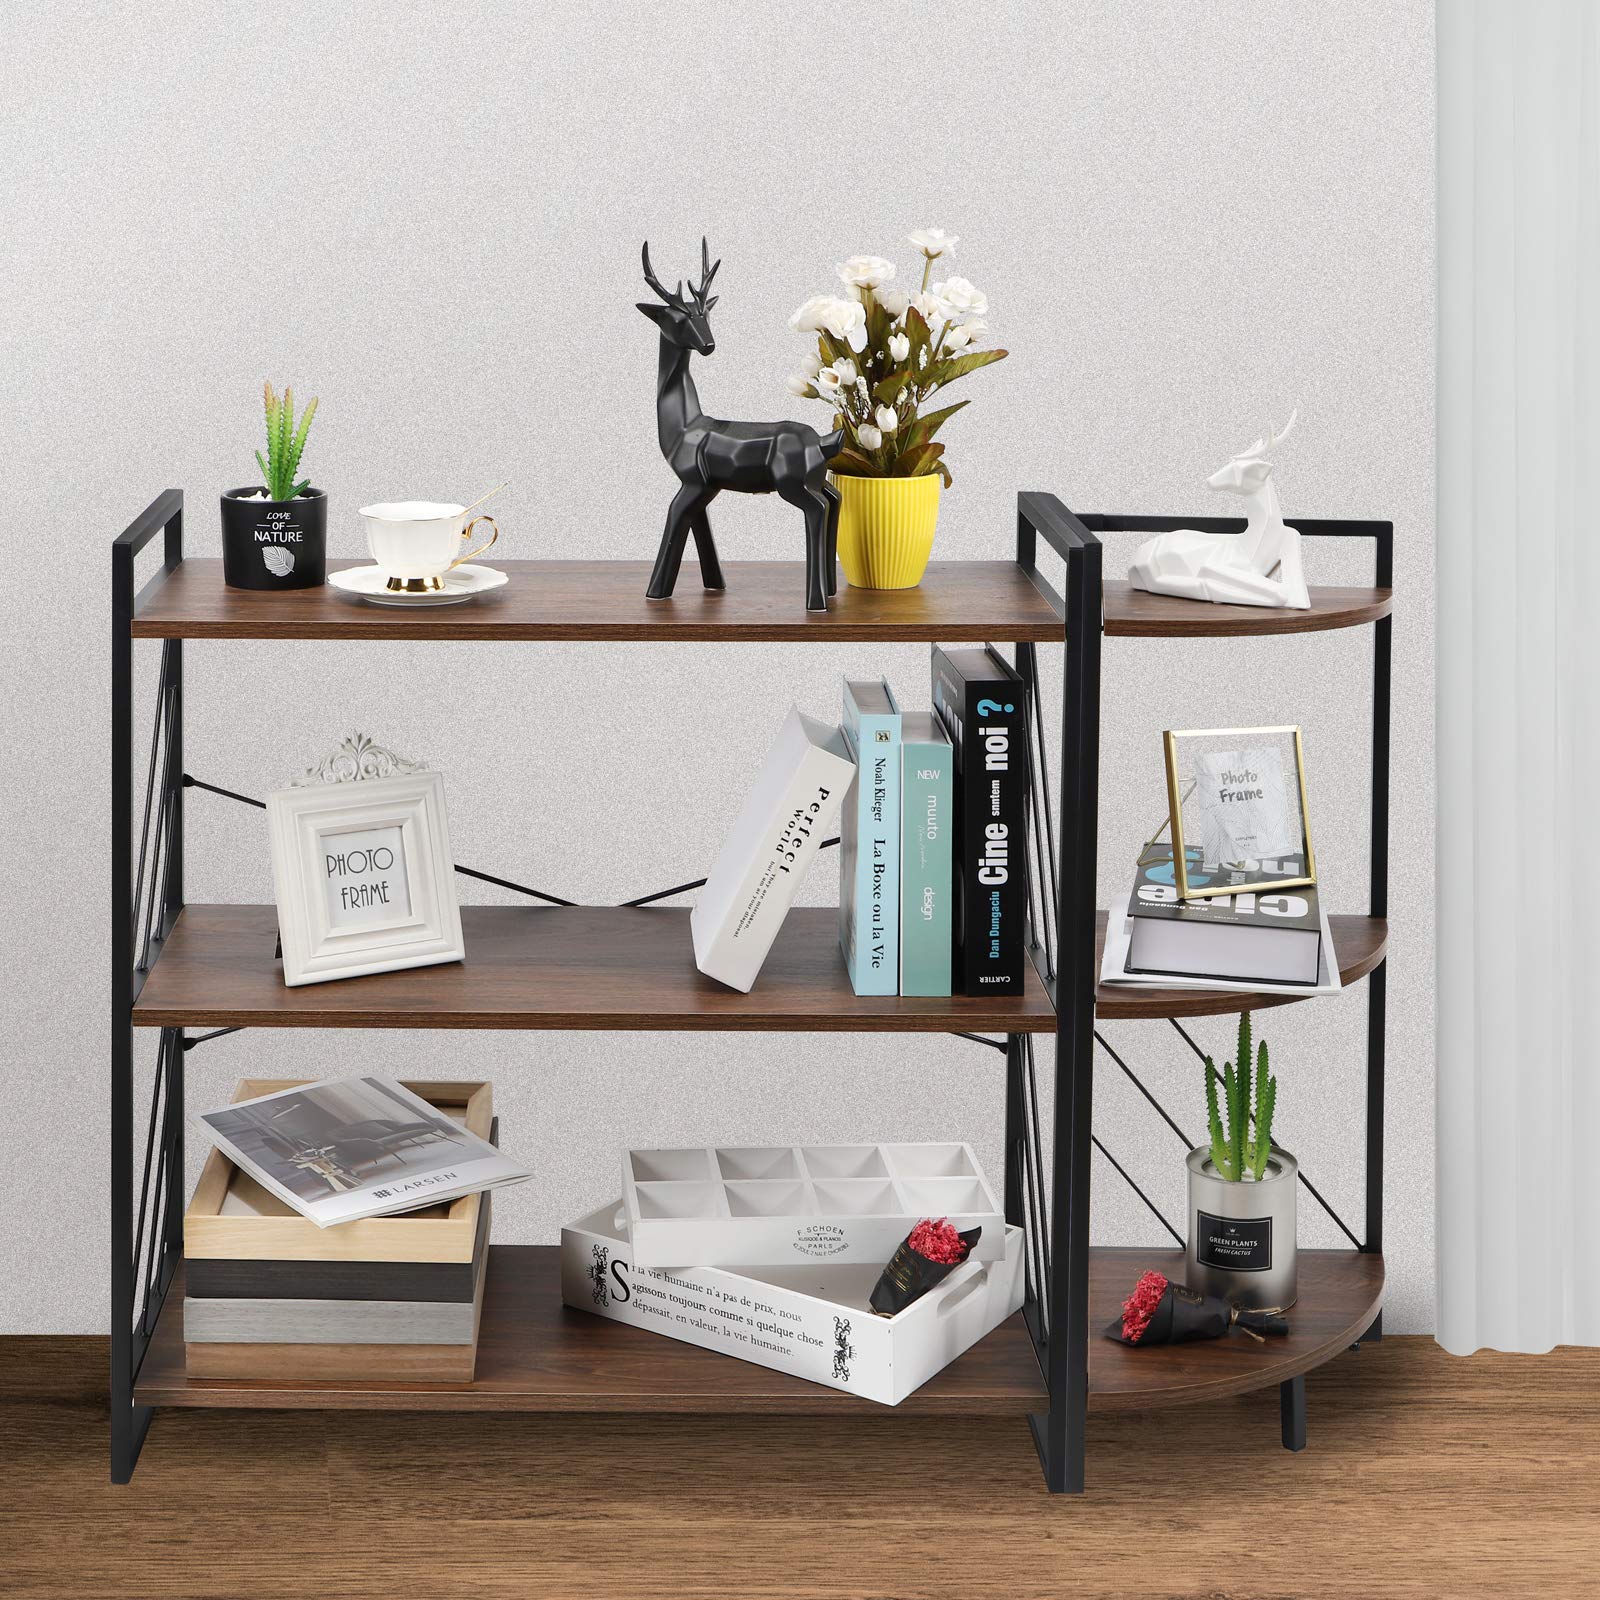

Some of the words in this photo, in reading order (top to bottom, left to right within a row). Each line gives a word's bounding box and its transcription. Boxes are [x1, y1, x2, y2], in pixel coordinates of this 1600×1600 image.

[266, 511, 291, 520] LOVE
[272, 521, 286, 531] OF
[254, 530, 304, 543] NATURE
[979, 727, 1008, 771] noi
[875, 758, 886, 785] Noah
[917, 770, 941, 780] NEW
[1220, 769, 1258, 785] Photo
[870, 788, 886, 822] Klieger
[1219, 788, 1264, 803] Frame
[779, 786, 830, 873] Perfect
[927, 795, 939, 840] muuto
[873, 839, 886, 858] La
[978, 823, 1008, 885] Cine
[326, 847, 394, 879] PHOTO
[873, 863, 885, 900] Boxe
[341, 881, 390, 911] FRAME
[921, 887, 935, 921] design
[872, 904, 881, 922] ou
[989, 891, 1002, 937] Dungaciu
[872, 927, 884, 940] la
[871, 944, 884, 969] Vie
[989, 939, 999, 958] Dan
[979, 975, 1011, 983] CARTIER
[392, 1172, 458, 1193] LARSEN
[1209, 1236, 1230, 1245] GREEN
[648, 1269, 661, 1280] vie
[664, 1272, 703, 1292] humaine
[706, 1286, 720, 1298] n'a
[723, 1293, 737, 1303] pas
[740, 1296, 751, 1307] de
[754, 1302, 776, 1315] prix,
[779, 1310, 802, 1322] nous
[631, 1283, 667, 1299] agissons
[669, 1293, 707, 1311] toujours
[709, 1307, 744, 1323] comme
[746, 1316, 753, 1326] si
[756, 1321, 794, 1338] quelque
[797, 1332, 824, 1347] chose
[632, 1299, 673, 1320] dépassait,
[675, 1314, 687, 1323] en
[690, 1319, 720, 1334] valeur,
[723, 1326, 731, 1337] la
[733, 1330, 748, 1342] vie
[750, 1334, 795, 1356] humaine.
